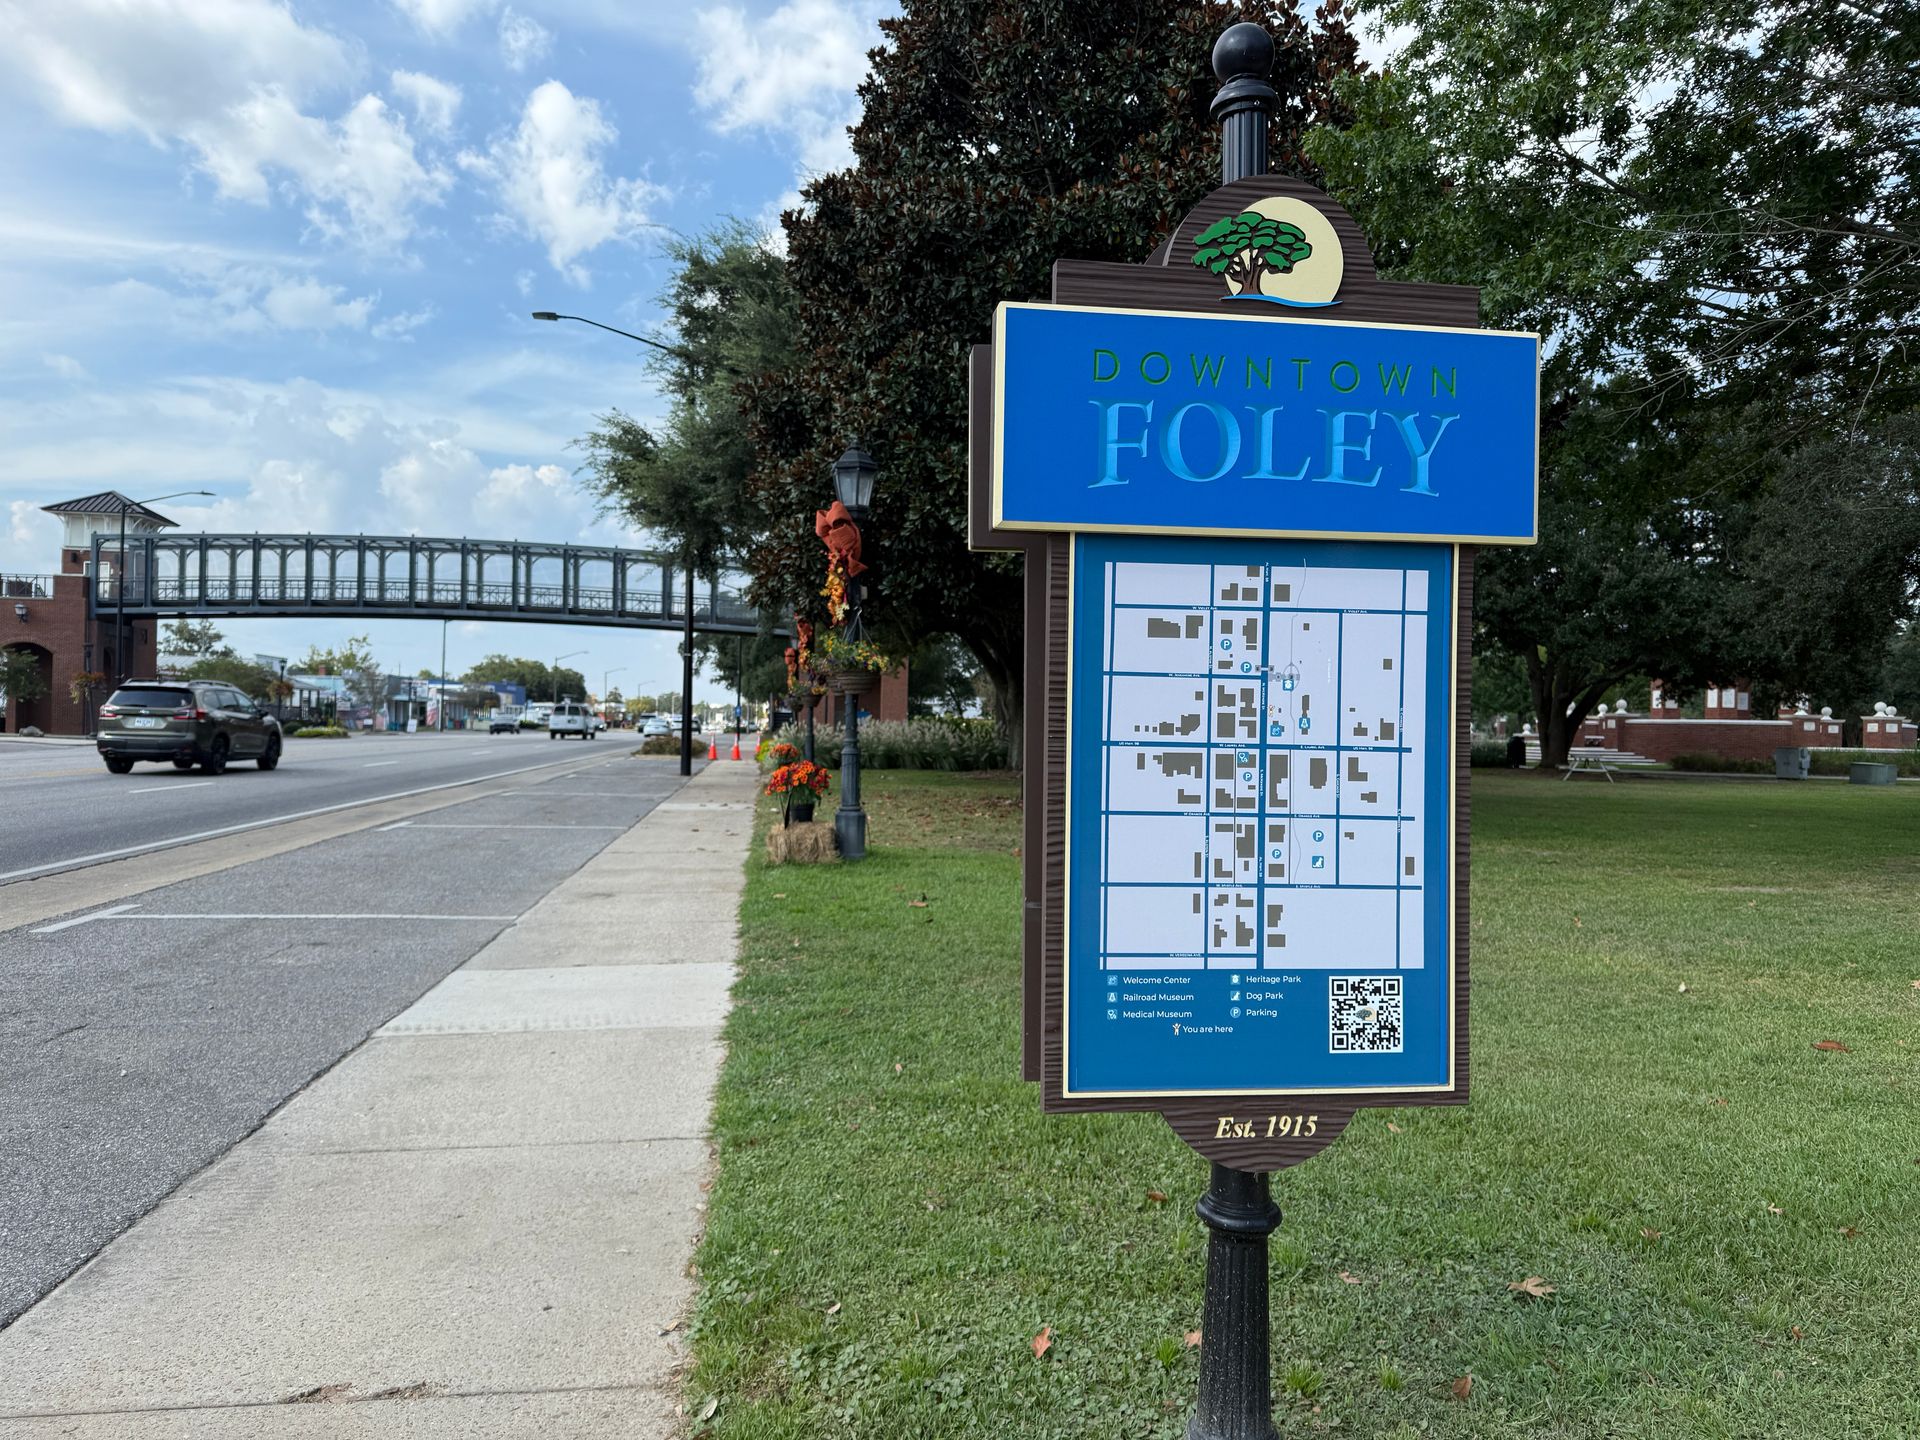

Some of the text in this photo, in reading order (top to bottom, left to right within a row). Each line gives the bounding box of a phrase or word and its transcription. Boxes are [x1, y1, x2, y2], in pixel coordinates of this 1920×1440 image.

[1092, 348, 1458, 399] DOWNTOWN
[1087, 398, 1461, 497] FOLEY
[1122, 976, 1162, 984] Welcome
[1246, 976, 1280, 985] Heritage
[1123, 993, 1194, 1001] Railroad Museum
[1246, 992, 1262, 1001] Dog
[1123, 1010, 1155, 1018] Medical
[1246, 1009, 1278, 1018] Parking
[1183, 1025, 1198, 1033] You
[1214, 1115, 1318, 1139] Est. 1915
